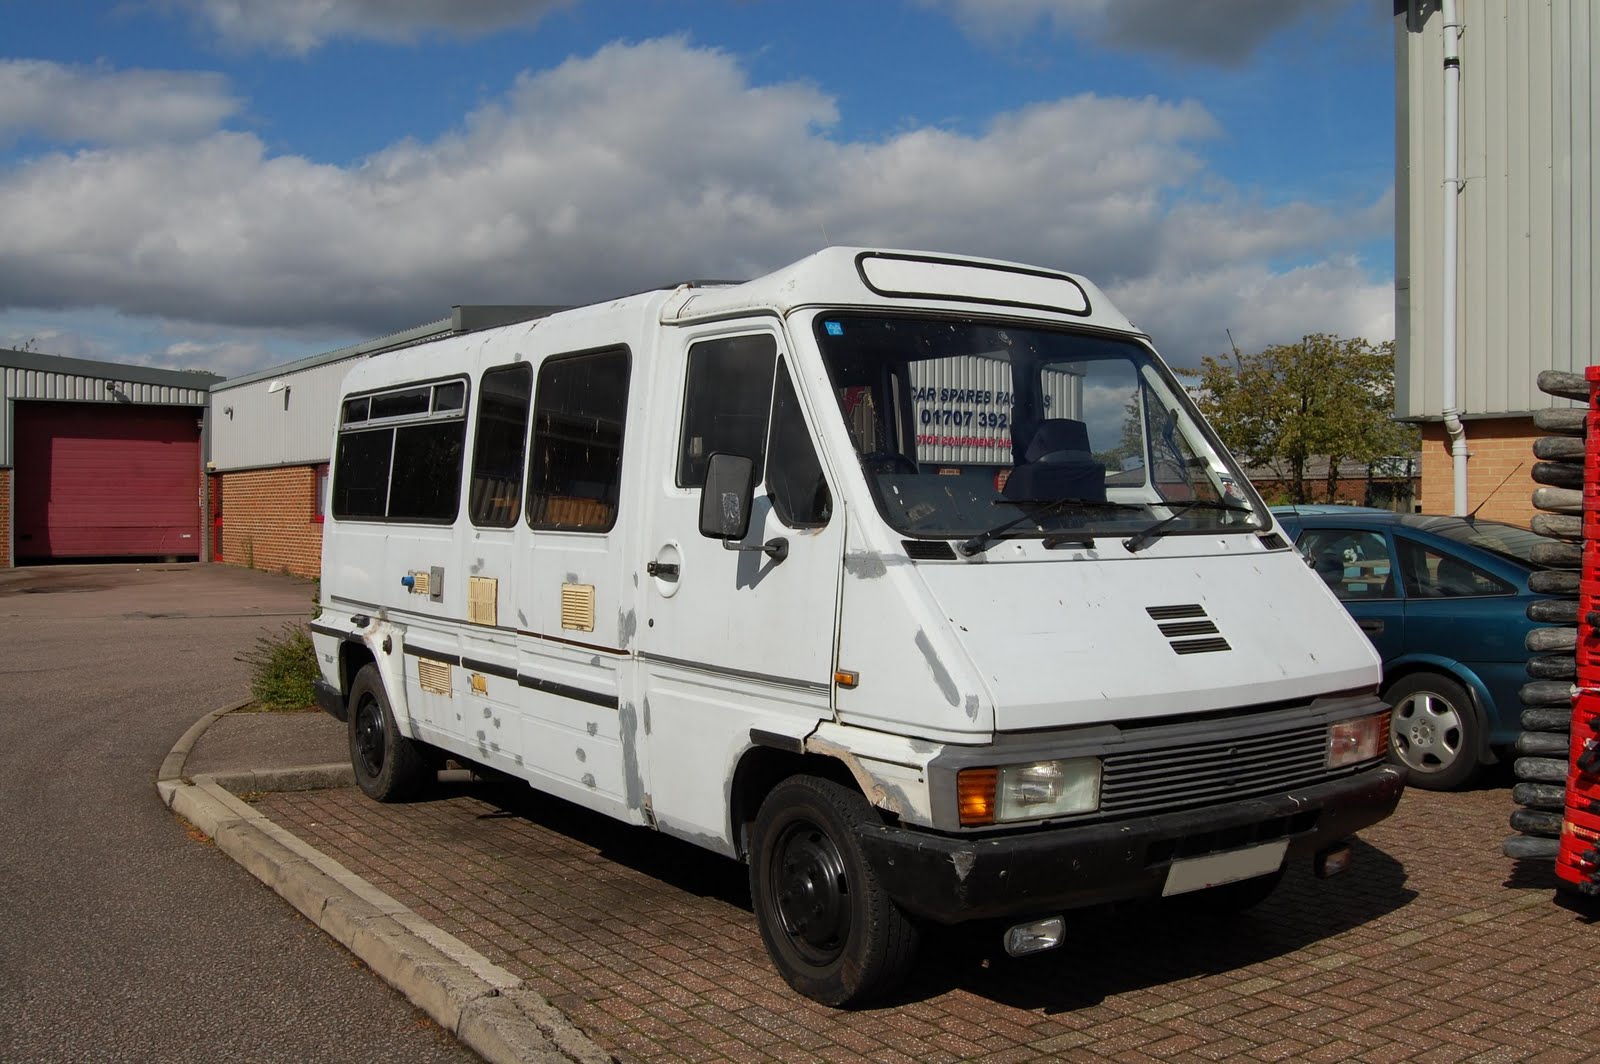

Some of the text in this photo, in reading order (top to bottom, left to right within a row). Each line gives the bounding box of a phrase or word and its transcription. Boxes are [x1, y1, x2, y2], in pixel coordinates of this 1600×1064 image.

[940, 388, 991, 404] SPARES
[921, 409, 1007, 428] 01707 392
[941, 436, 995, 448] COMPONENT
